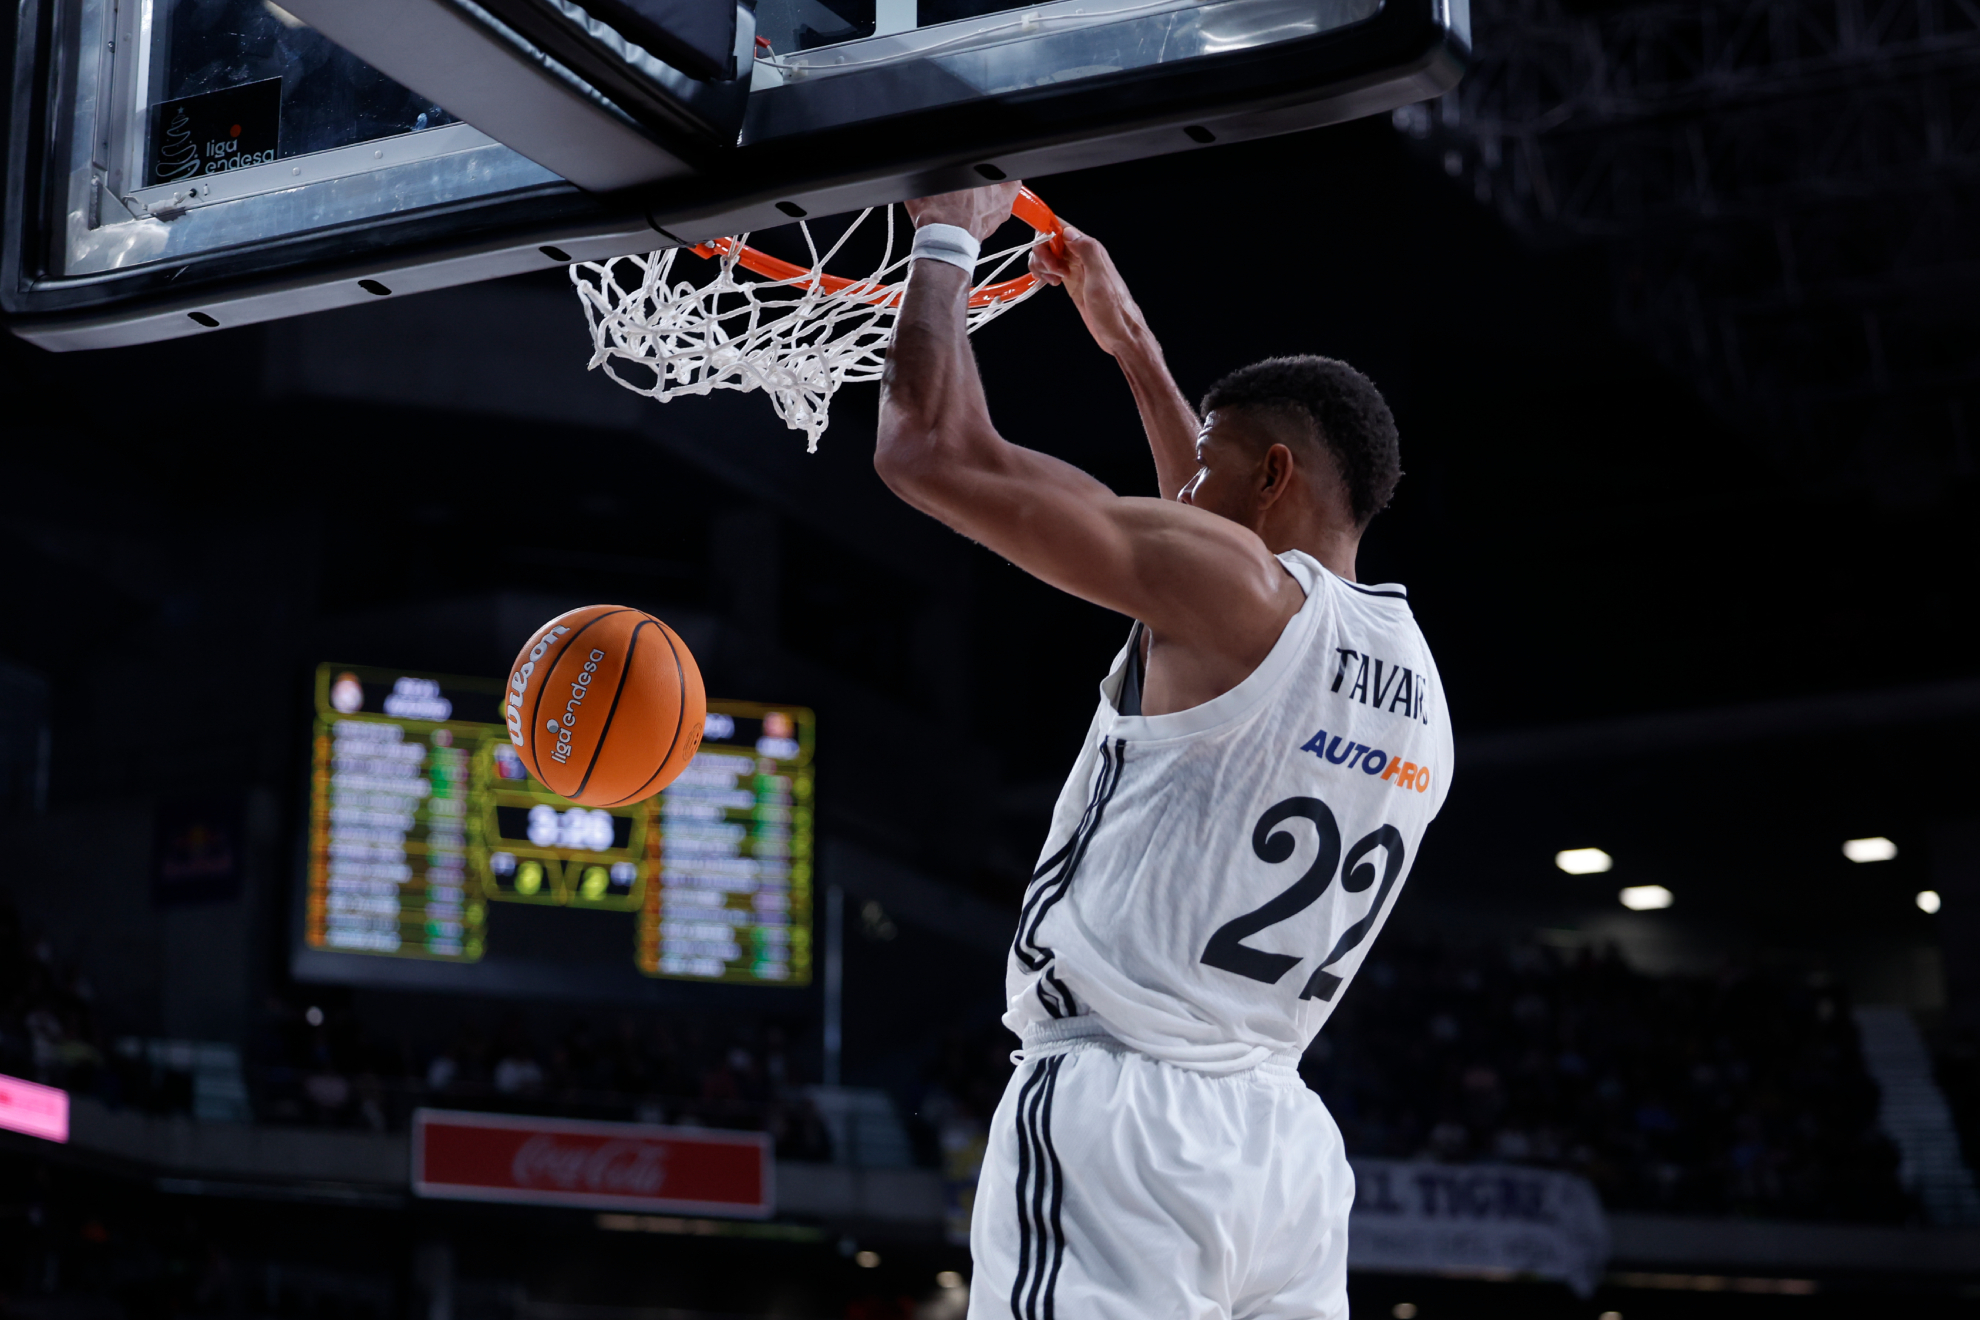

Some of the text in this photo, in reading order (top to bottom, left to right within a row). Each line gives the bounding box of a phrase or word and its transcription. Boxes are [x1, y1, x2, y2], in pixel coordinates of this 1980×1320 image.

[205, 149, 275, 174] endesa
[206, 139, 238, 158] liga
[551, 648, 605, 764] liga endesa
[1199, 796, 1405, 1002] 22
